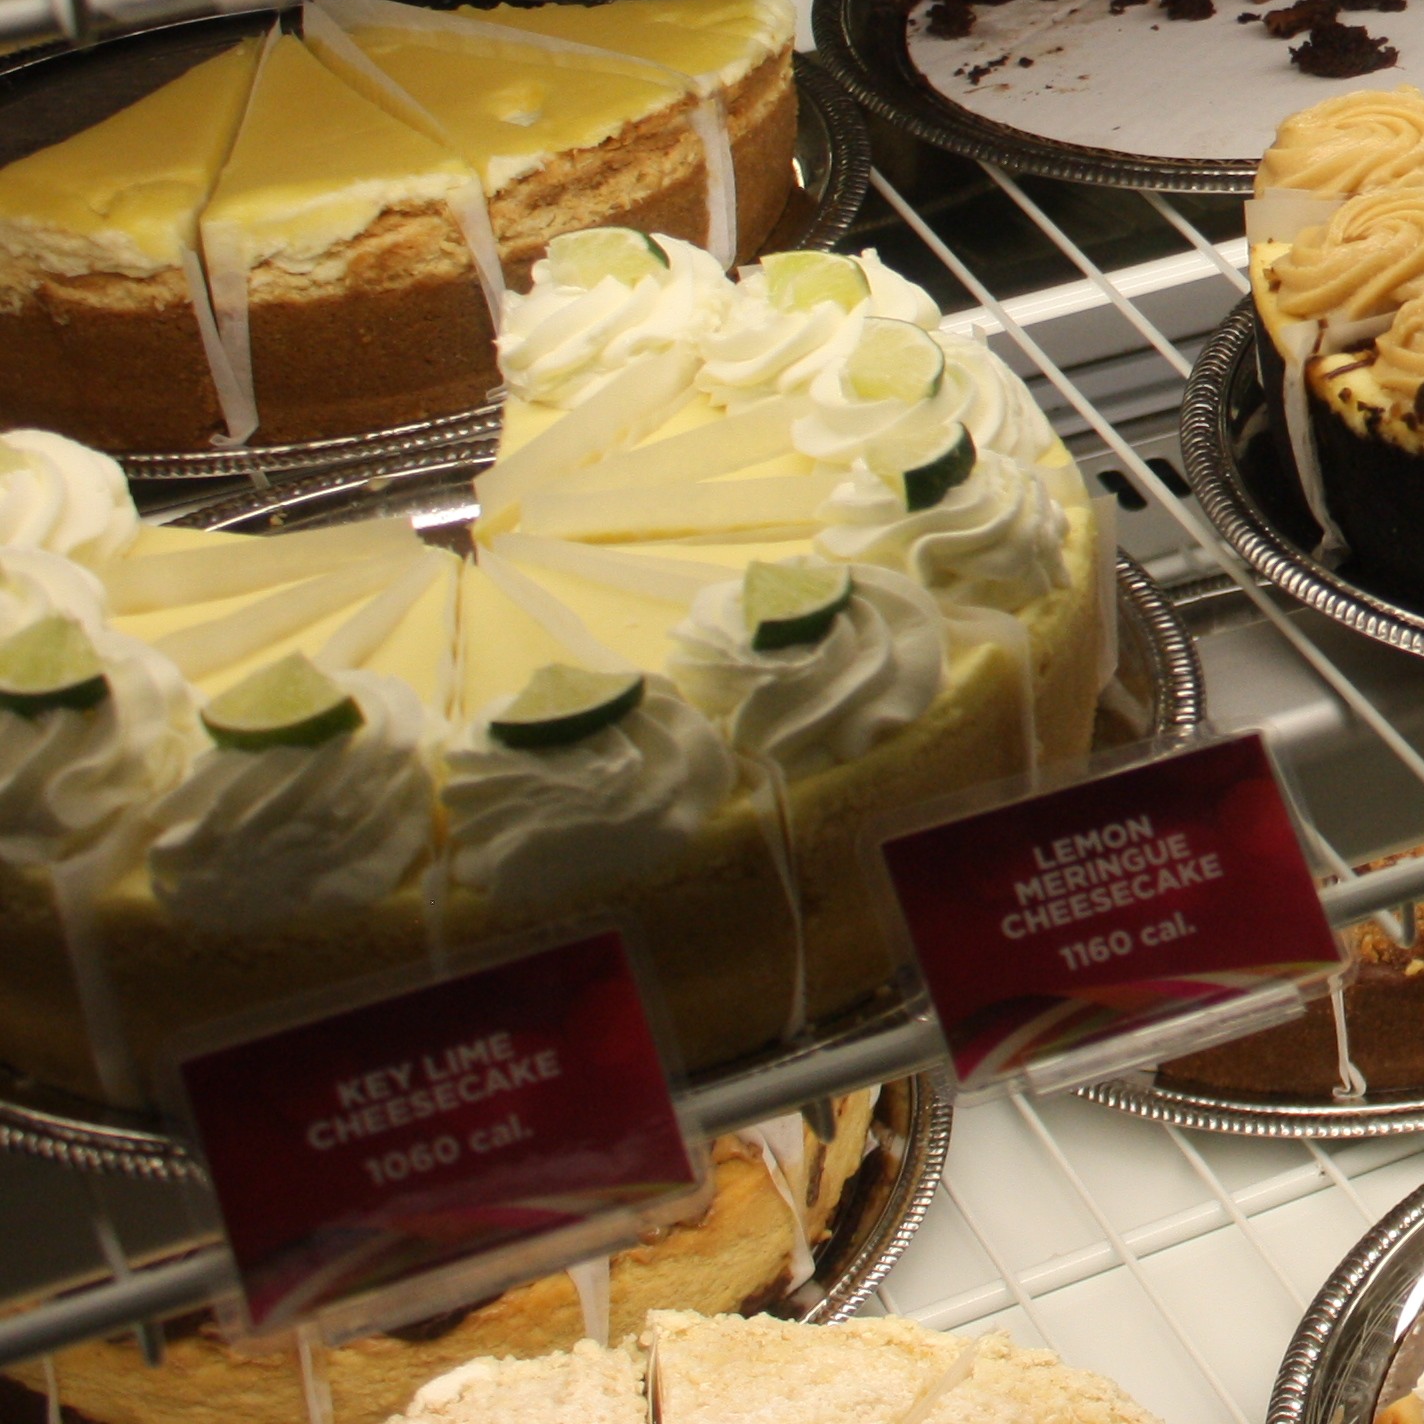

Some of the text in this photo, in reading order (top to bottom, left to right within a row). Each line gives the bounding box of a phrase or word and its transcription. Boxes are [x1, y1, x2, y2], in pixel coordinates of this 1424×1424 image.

[1013, 834, 1192, 906] MERINGUE
[1033, 815, 1154, 869] LEMON
[1001, 853, 1223, 940] CHEESECAKE
[1058, 912, 1196, 971] 1160 cal.
[305, 1049, 562, 1152] CHEESECAKE
[335, 1031, 515, 1110] KEY LIME
[365, 1114, 535, 1187] 1060 cal.
